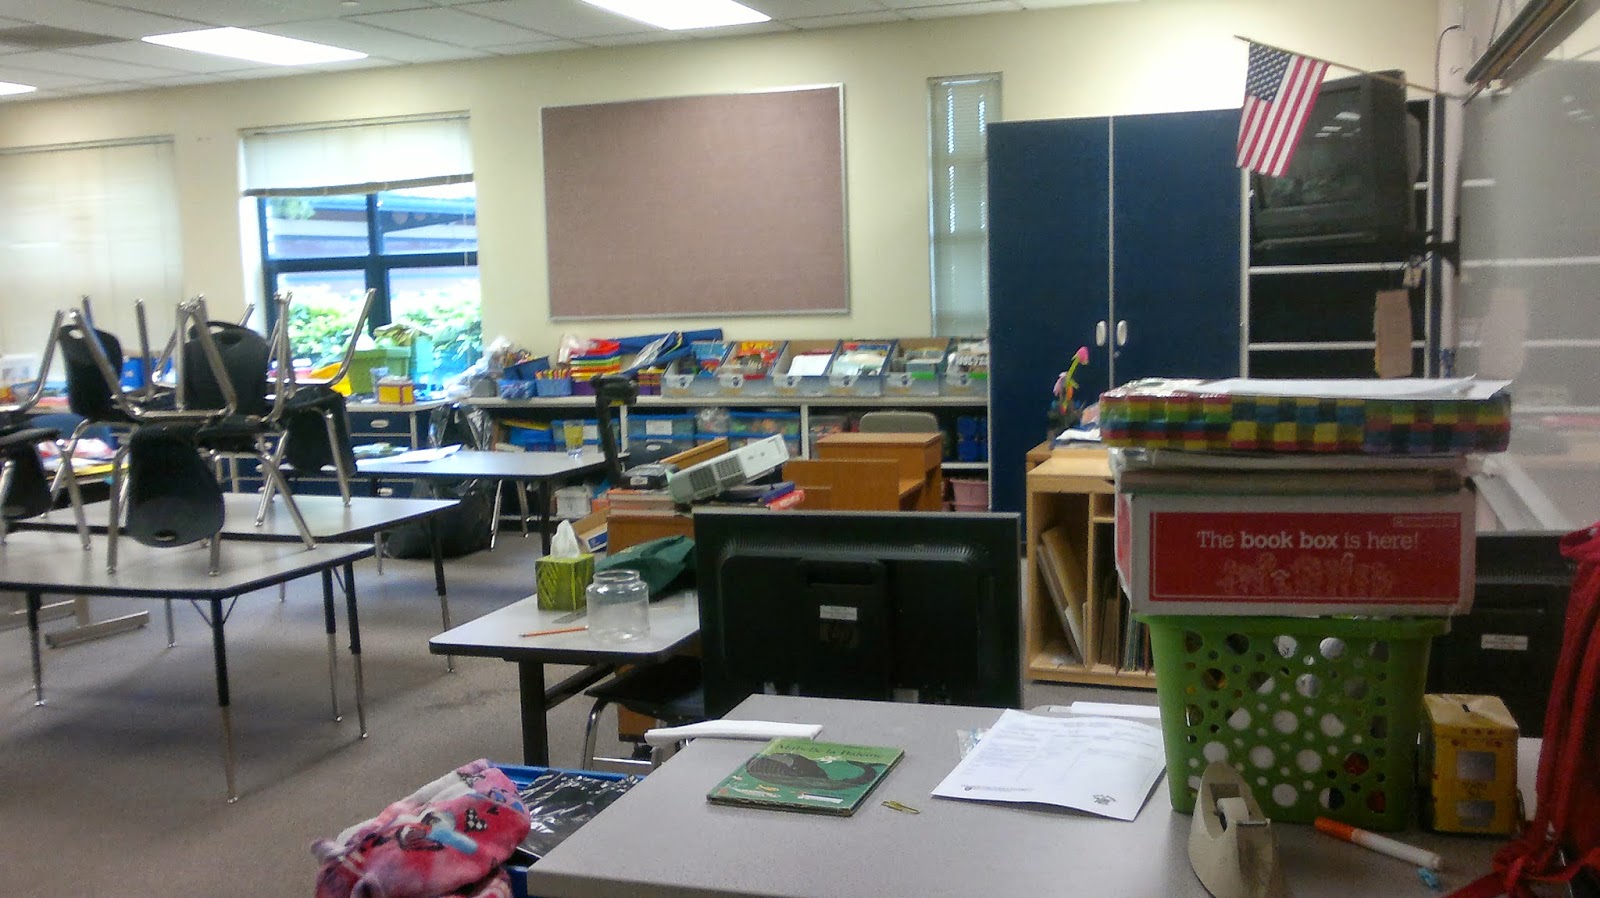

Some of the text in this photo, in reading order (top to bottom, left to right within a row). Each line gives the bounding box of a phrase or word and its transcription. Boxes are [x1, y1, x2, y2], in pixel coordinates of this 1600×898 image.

[1196, 530, 1419, 550] The book box is here!
